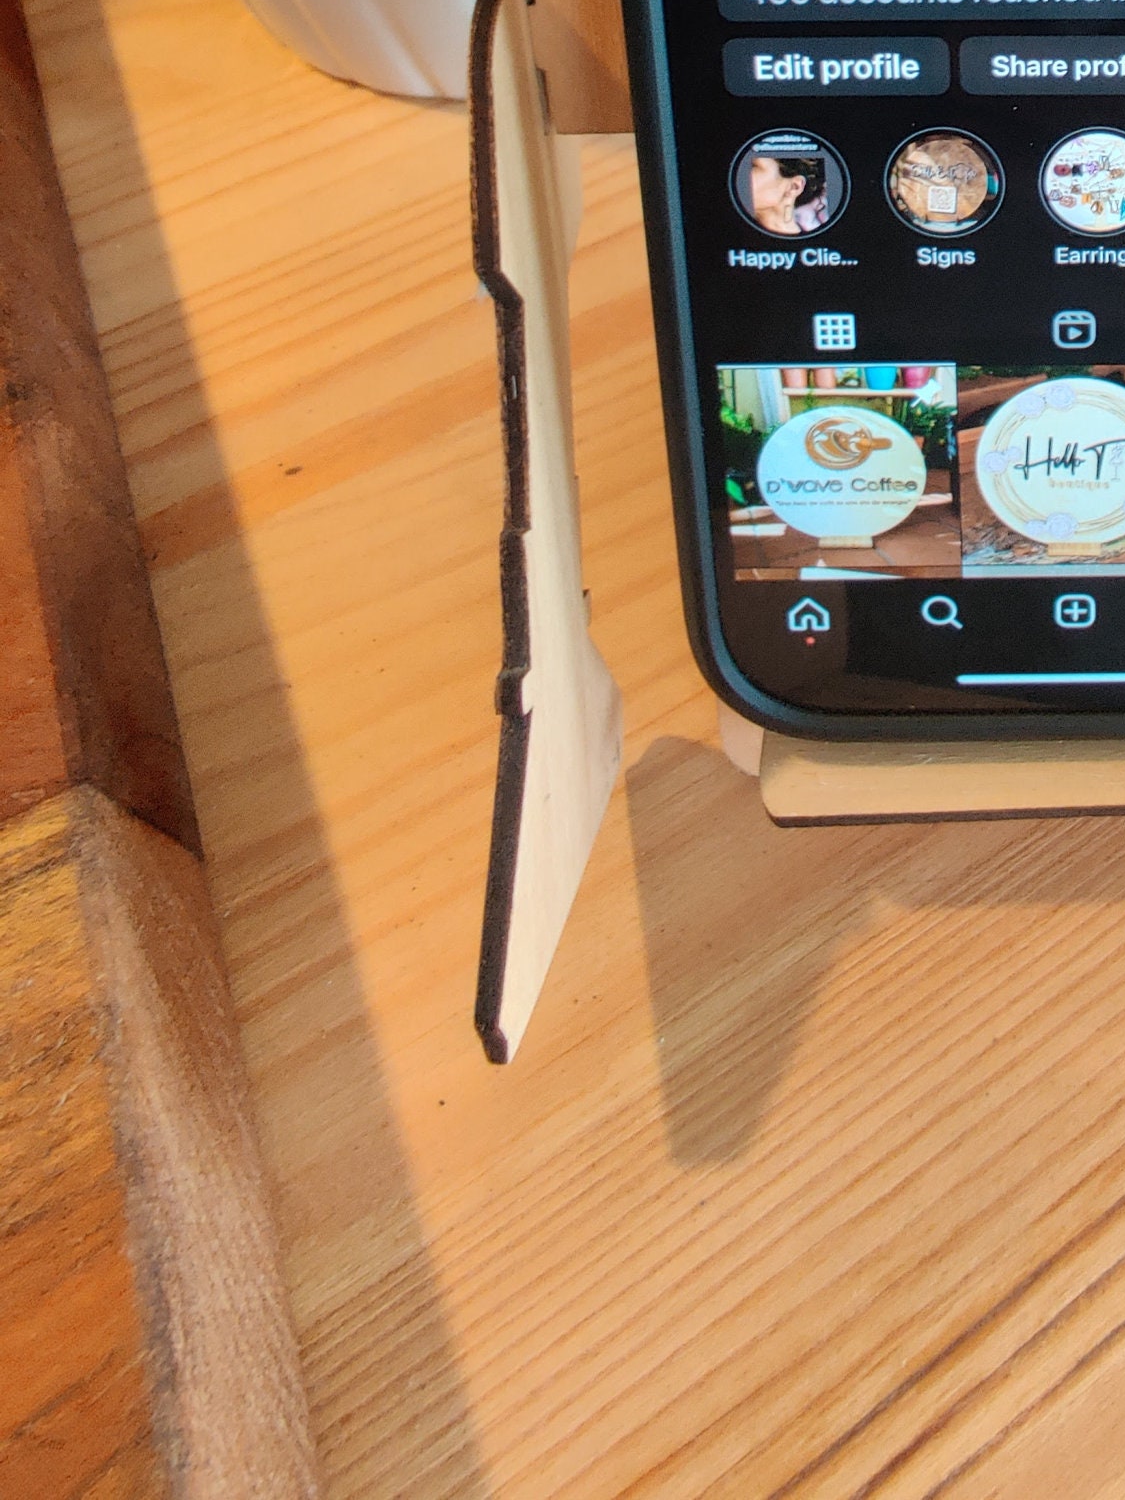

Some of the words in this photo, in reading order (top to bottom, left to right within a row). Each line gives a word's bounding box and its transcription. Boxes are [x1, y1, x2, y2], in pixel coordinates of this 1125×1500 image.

[754, 53, 815, 81] Edit
[820, 52, 921, 86] profile
[990, 54, 1069, 79] Share
[728, 249, 797, 270] Happy
[800, 248, 859, 267] Clie...
[916, 247, 976, 269] Signs
[850, 477, 918, 493] Coffee
